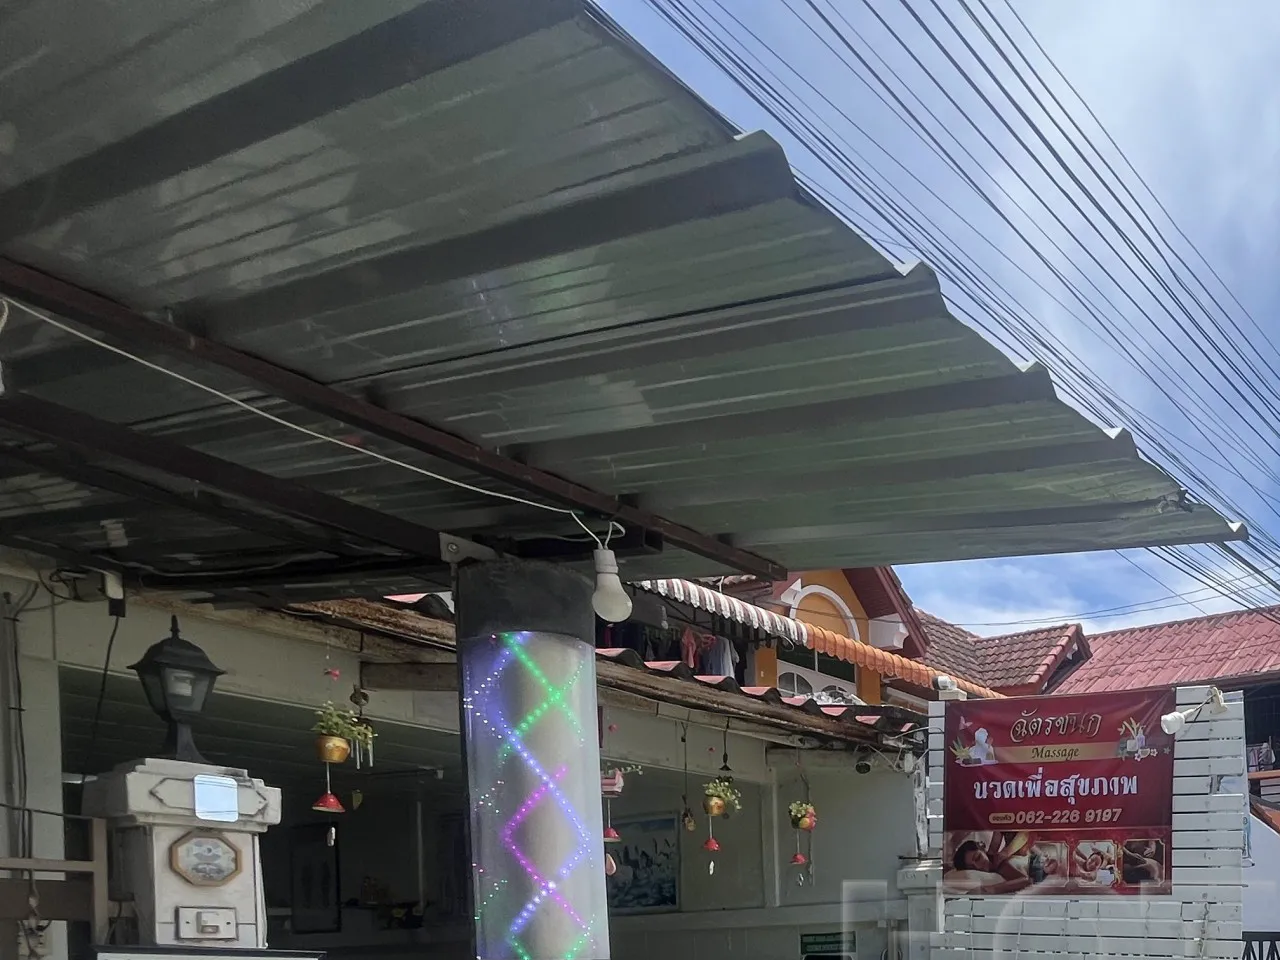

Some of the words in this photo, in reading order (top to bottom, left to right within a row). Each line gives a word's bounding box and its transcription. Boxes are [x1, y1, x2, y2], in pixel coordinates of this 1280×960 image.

[1031, 747, 1080, 761] Massage
[973, 767, 1138, 805] นวดเพื่อสุขภาพ
[1015, 810, 1080, 824] 062-226
